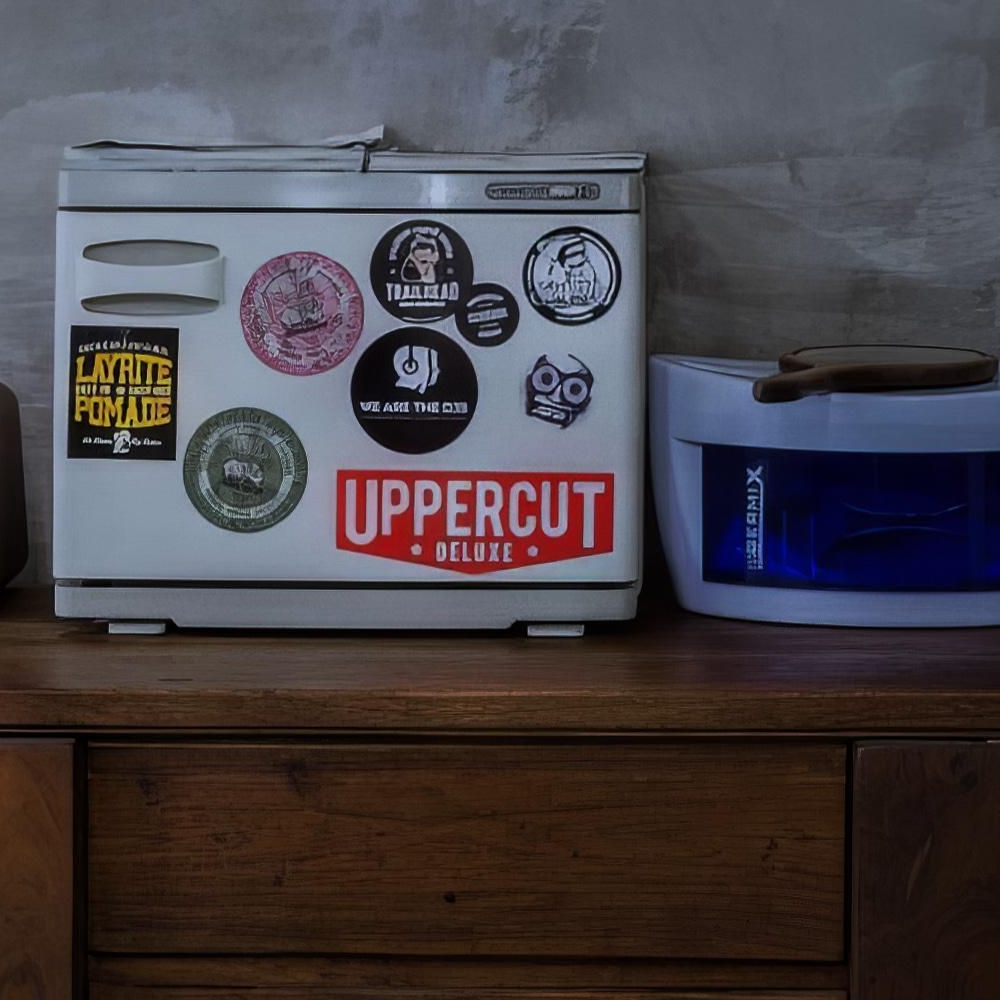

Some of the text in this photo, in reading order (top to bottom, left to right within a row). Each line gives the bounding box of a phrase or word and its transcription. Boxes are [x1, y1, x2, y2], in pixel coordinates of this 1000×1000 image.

[76, 353, 173, 385] LAYRITE
[75, 396, 172, 428] POMADE
[345, 479, 605, 549] UPPERCUT
[436, 541, 513, 563] DELUXE
